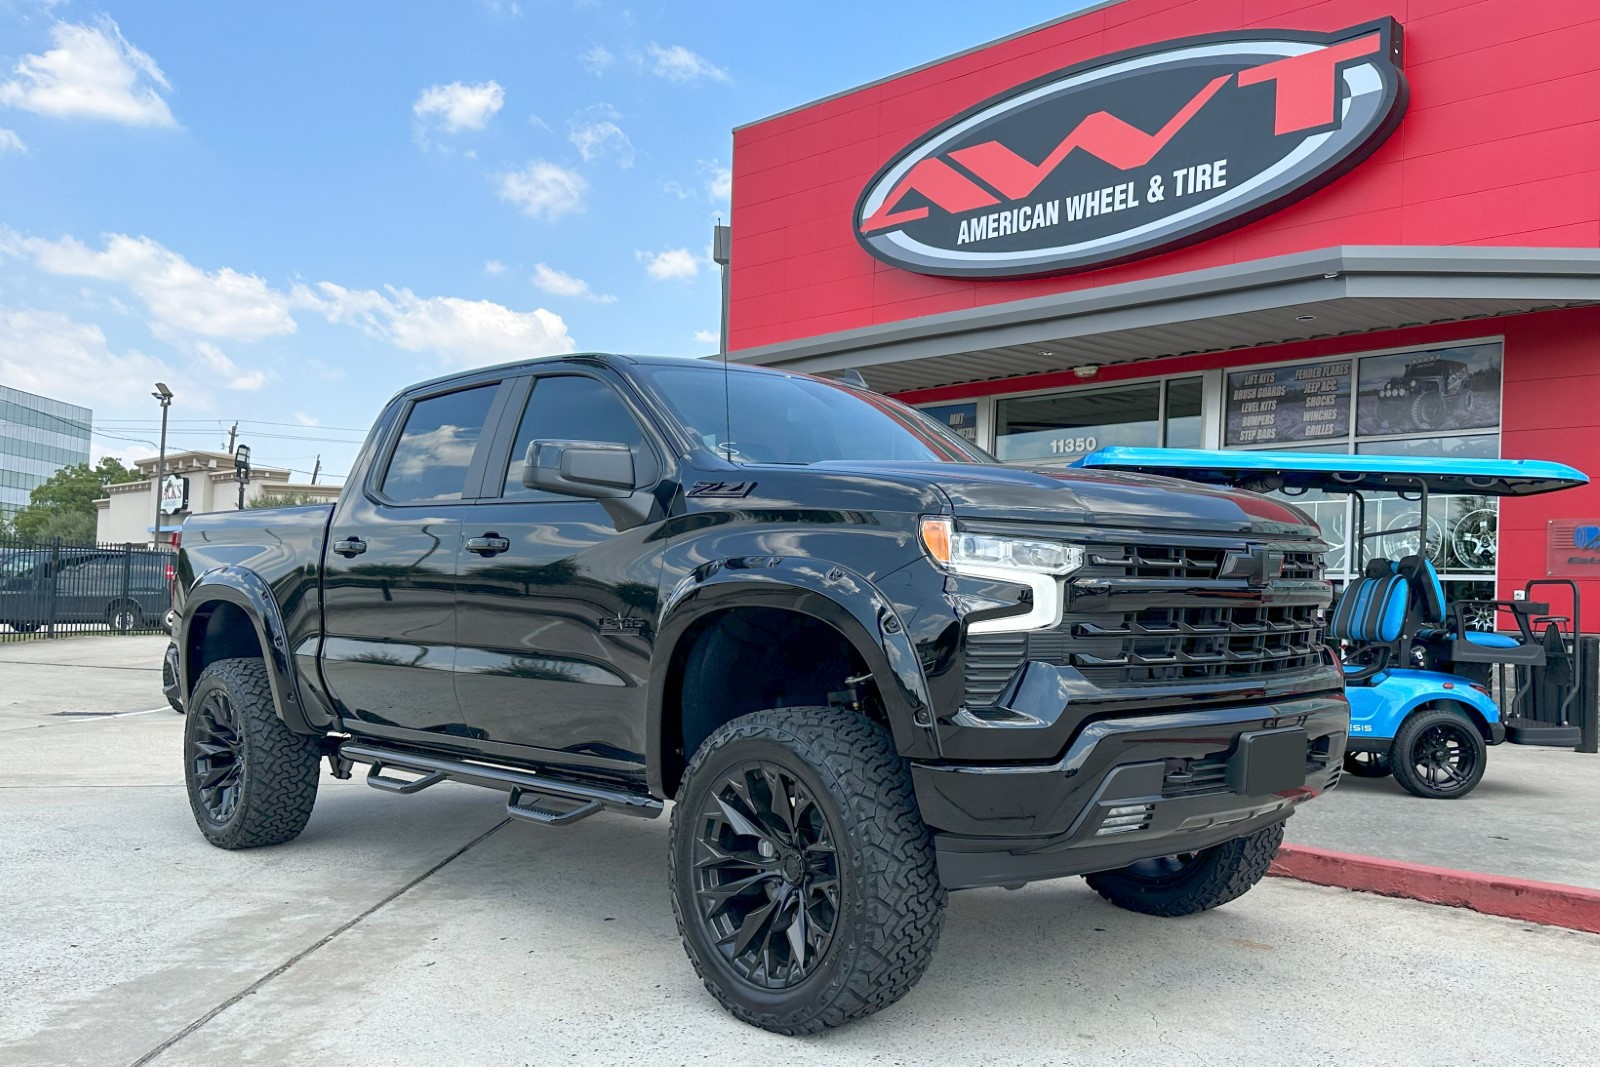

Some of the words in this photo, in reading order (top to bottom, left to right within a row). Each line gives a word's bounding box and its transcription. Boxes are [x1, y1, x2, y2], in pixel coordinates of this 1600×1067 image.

[861, 34, 1381, 233] AWT
[956, 199, 1060, 245] AMERICAN
[1065, 181, 1140, 222] WHEEL
[1146, 174, 1165, 203] &
[1172, 158, 1228, 197] TIRE
[1245, 374, 1258, 385] LIFT
[1259, 372, 1275, 383] KITS
[1295, 368, 1321, 379] FENDER
[1322, 365, 1349, 377] FLARES
[1234, 388, 1257, 400] BRUSH
[1257, 385, 1286, 398] GUARDS
[1304, 381, 1320, 393] JEEP
[1241, 402, 1259, 412] LEVEL
[1260, 400, 1277, 411] KITS
[1305, 395, 1336, 407] SHOCKS
[1241, 414, 1275, 427] BUMPERS
[1303, 409, 1337, 421] WINCHES
[1240, 430, 1256, 441] STEP
[1257, 427, 1277, 440] BARS
[1305, 423, 1335, 436] GRILLES
[1050, 436, 1098, 454] 11350
